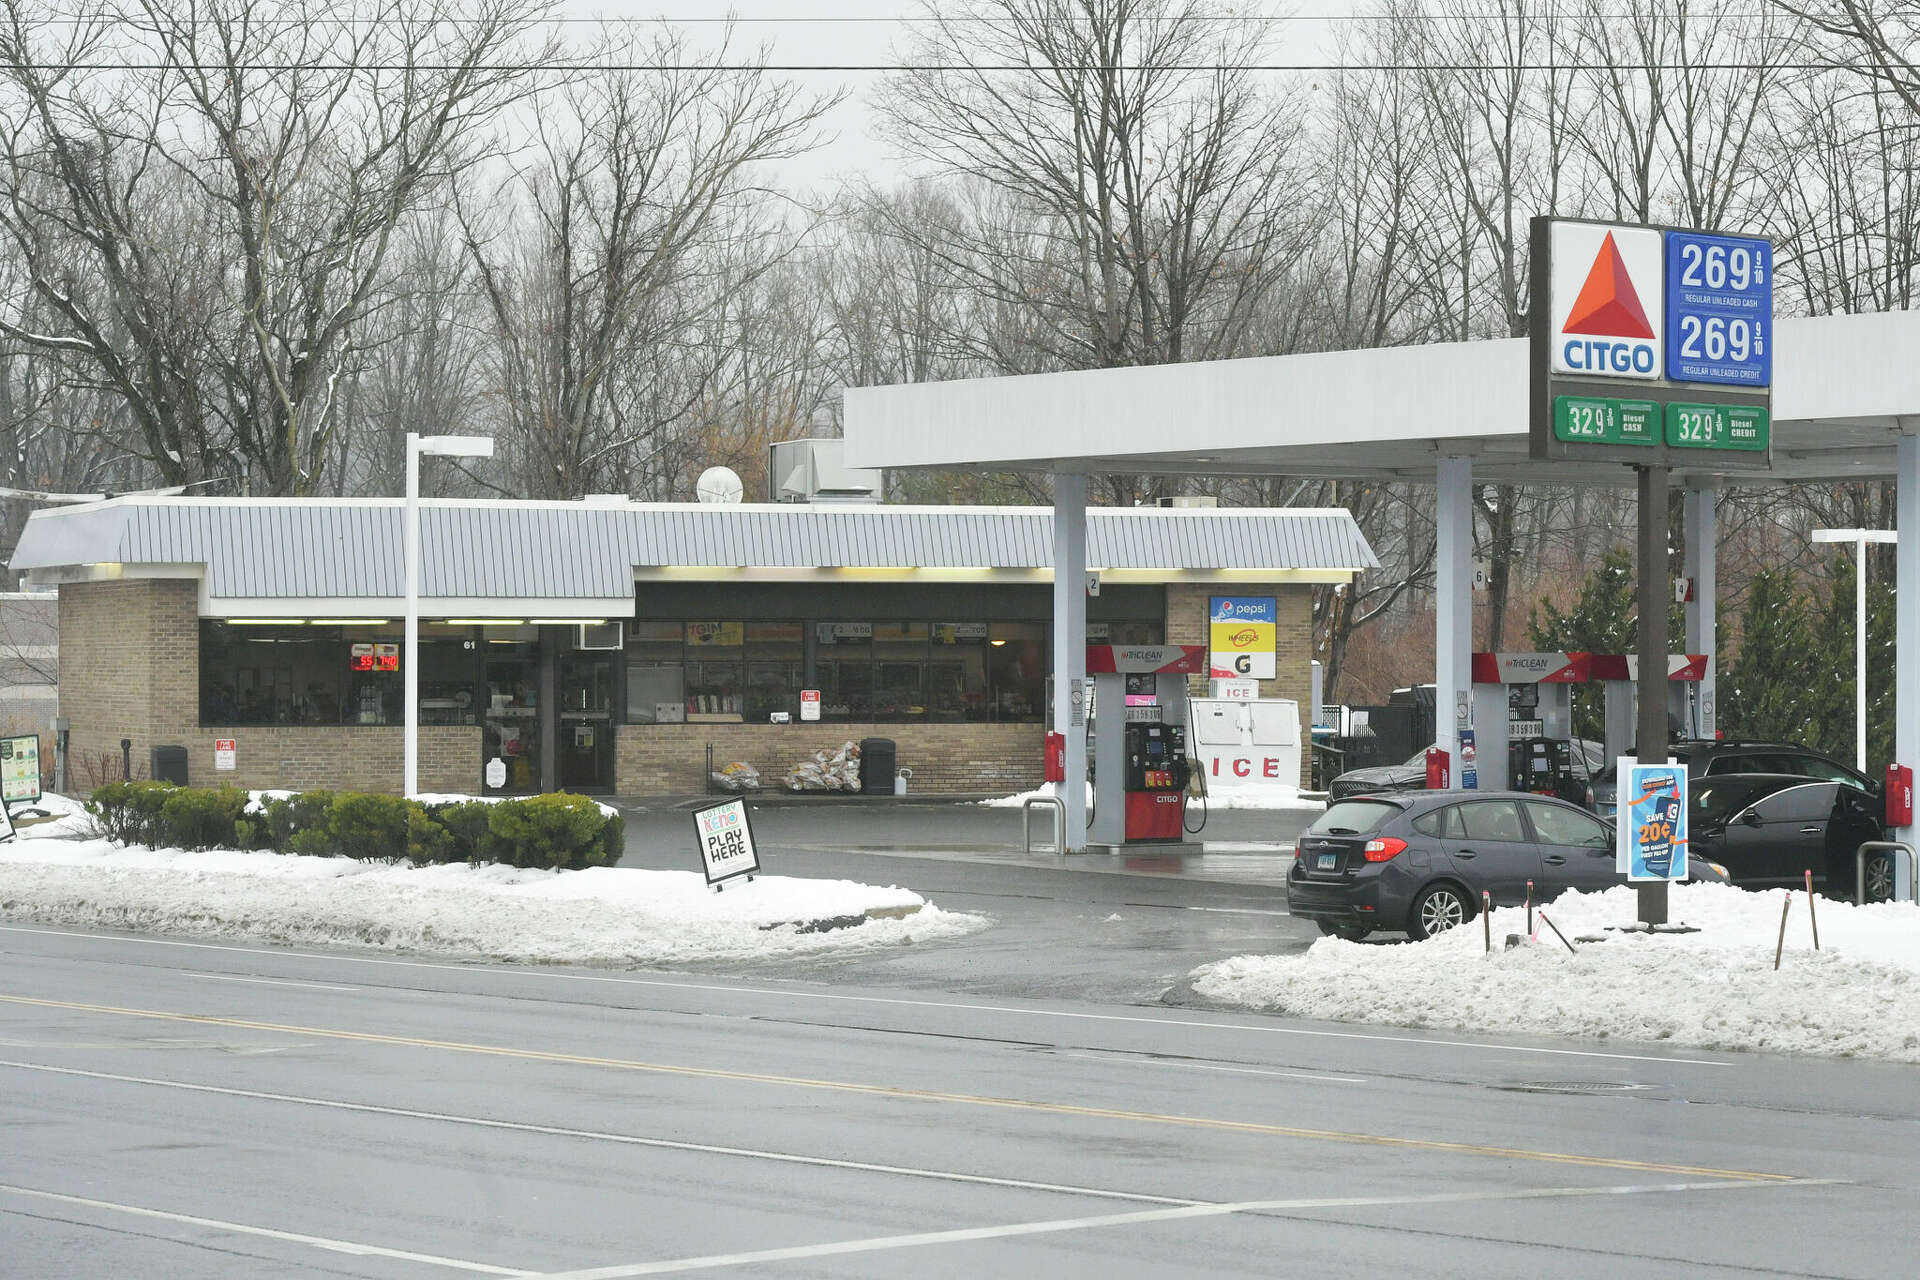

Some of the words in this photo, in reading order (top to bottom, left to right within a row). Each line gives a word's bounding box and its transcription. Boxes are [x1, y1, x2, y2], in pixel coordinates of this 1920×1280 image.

[1682, 244, 1750, 290] 269
[1685, 294, 1711, 304] REGULAR
[1712, 296, 1741, 306] UNLEADED
[1742, 298, 1758, 307] CASH
[1681, 316, 1750, 361] 269
[1564, 341, 1654, 373] CITGO
[1683, 366, 1709, 376] REGULAR
[1710, 368, 1739, 378] UNLEADED
[1740, 370, 1760, 379] CREDIT
[1569, 407, 1604, 434] 329
[1623, 415, 1645, 424] Diesel
[1731, 420, 1753, 429] Diesel
[1623, 423, 1642, 432] CASH
[1679, 413, 1713, 440] 329
[1731, 428, 1756, 438] CREDIT
[1476, 571, 1482, 582] 6
[1091, 578, 1097, 590] 2
[1236, 604, 1266, 615] pepsi
[464, 641, 476, 650] 61
[361, 655, 373, 666] 55
[1235, 655, 1251, 674] G
[1227, 688, 1250, 697] ICE
[1213, 757, 1279, 778] ICE
[702, 803, 736, 819] LOTTERY
[1646, 813, 1664, 823] SAVE
[708, 828, 742, 850] PLAY
[1639, 822, 1671, 843] 20¢
[711, 841, 746, 863] HERE
